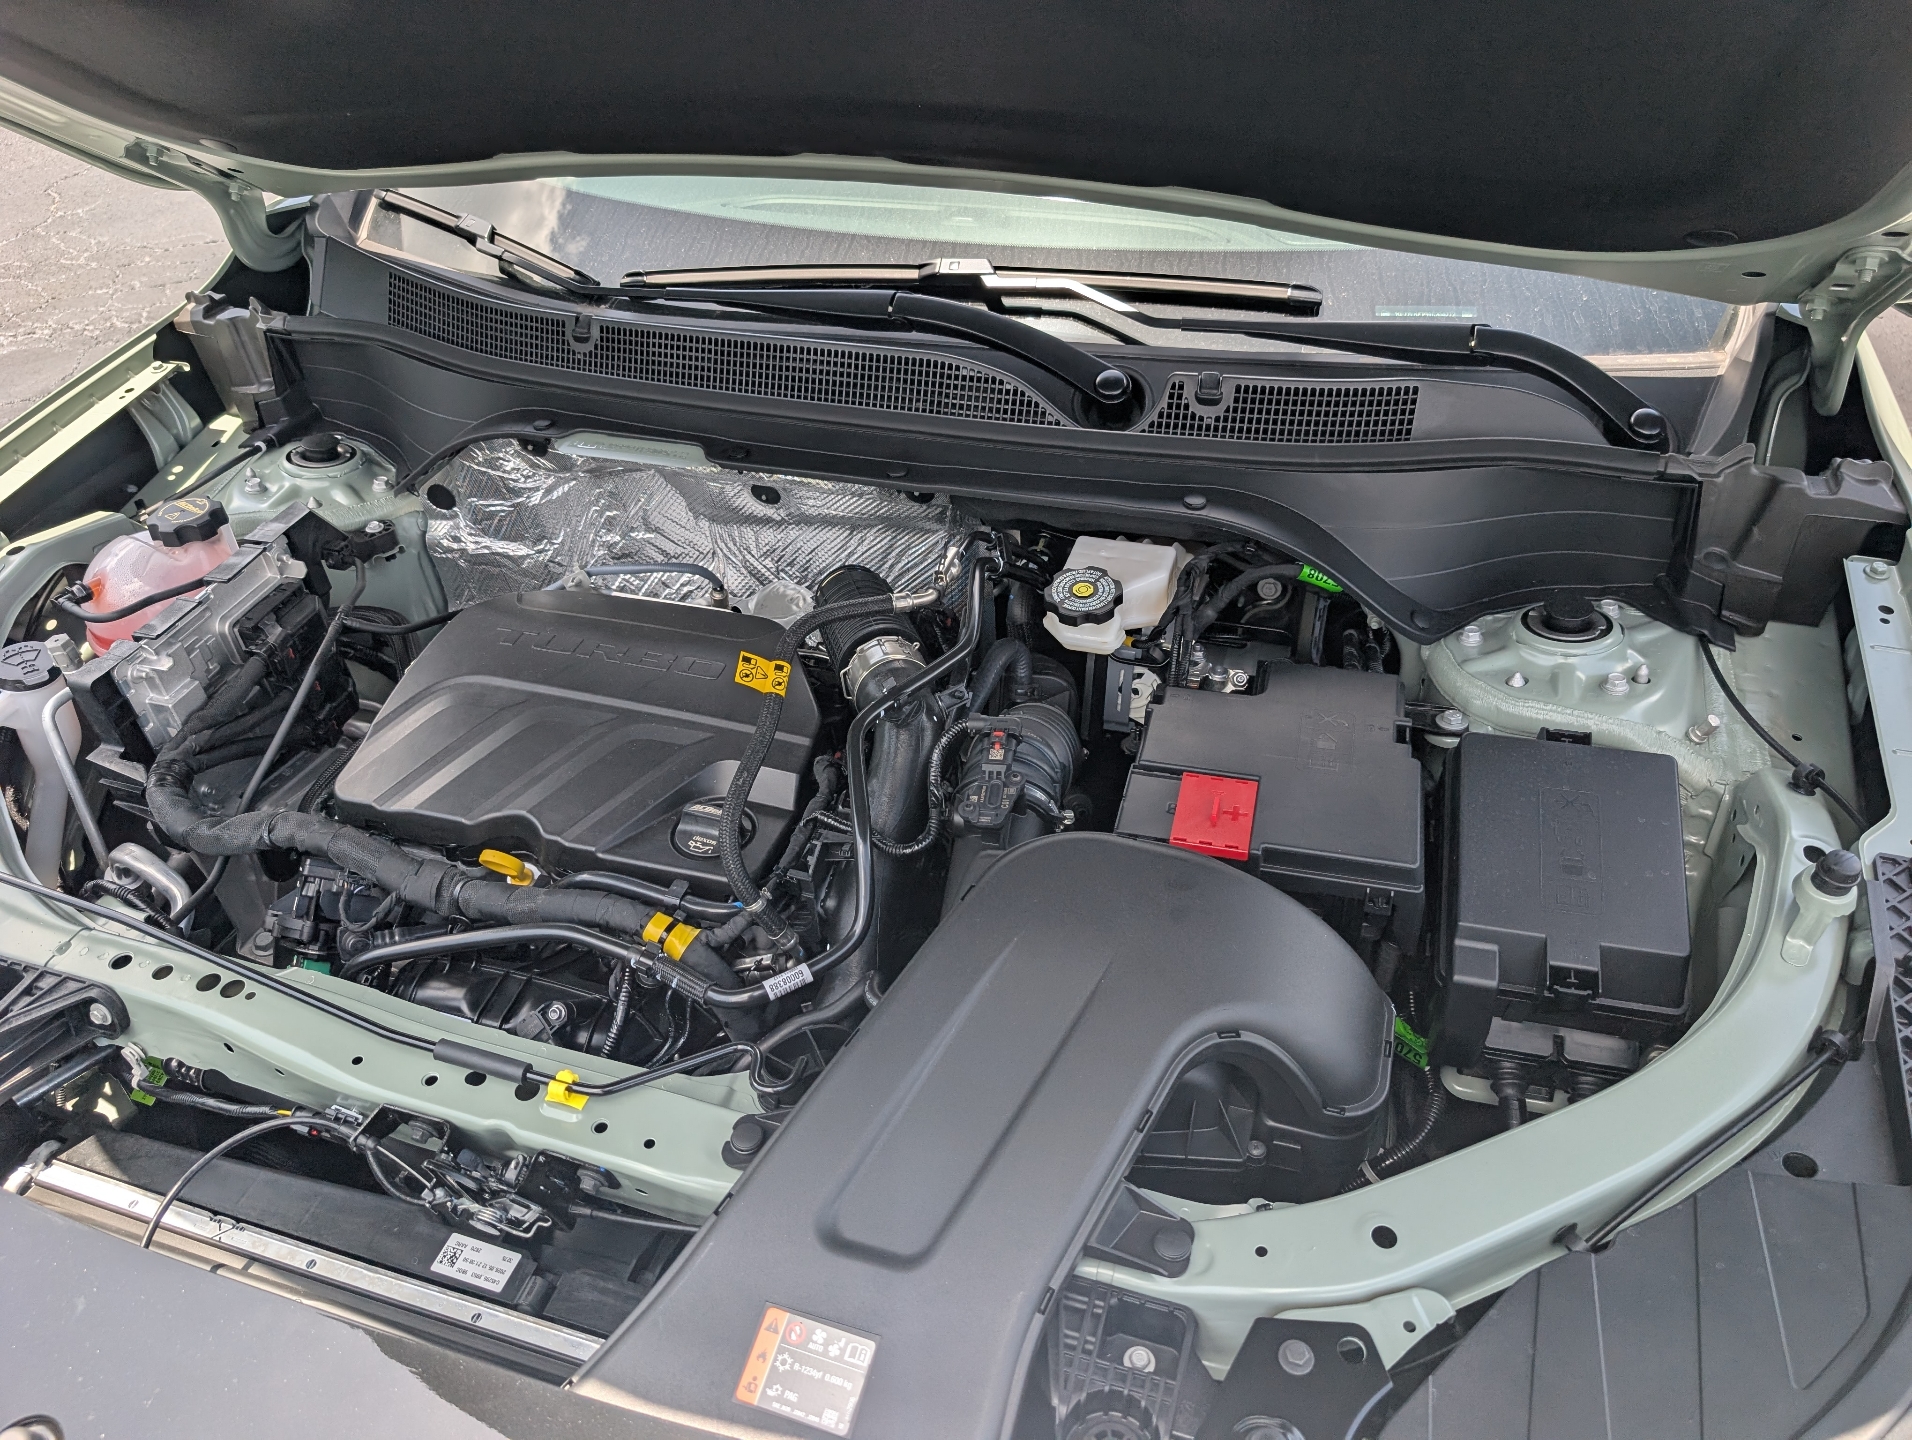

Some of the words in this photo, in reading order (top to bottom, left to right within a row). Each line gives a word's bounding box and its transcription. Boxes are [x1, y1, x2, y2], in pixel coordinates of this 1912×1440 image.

[497, 628, 727, 680] TURBO
[769, 969, 804, 992] 60008388
[807, 1342, 824, 1353] AUTO
[793, 1362, 823, 1379] R-1234yf
[842, 1378, 853, 1390] kg
[783, 1390, 799, 1403] PAG
